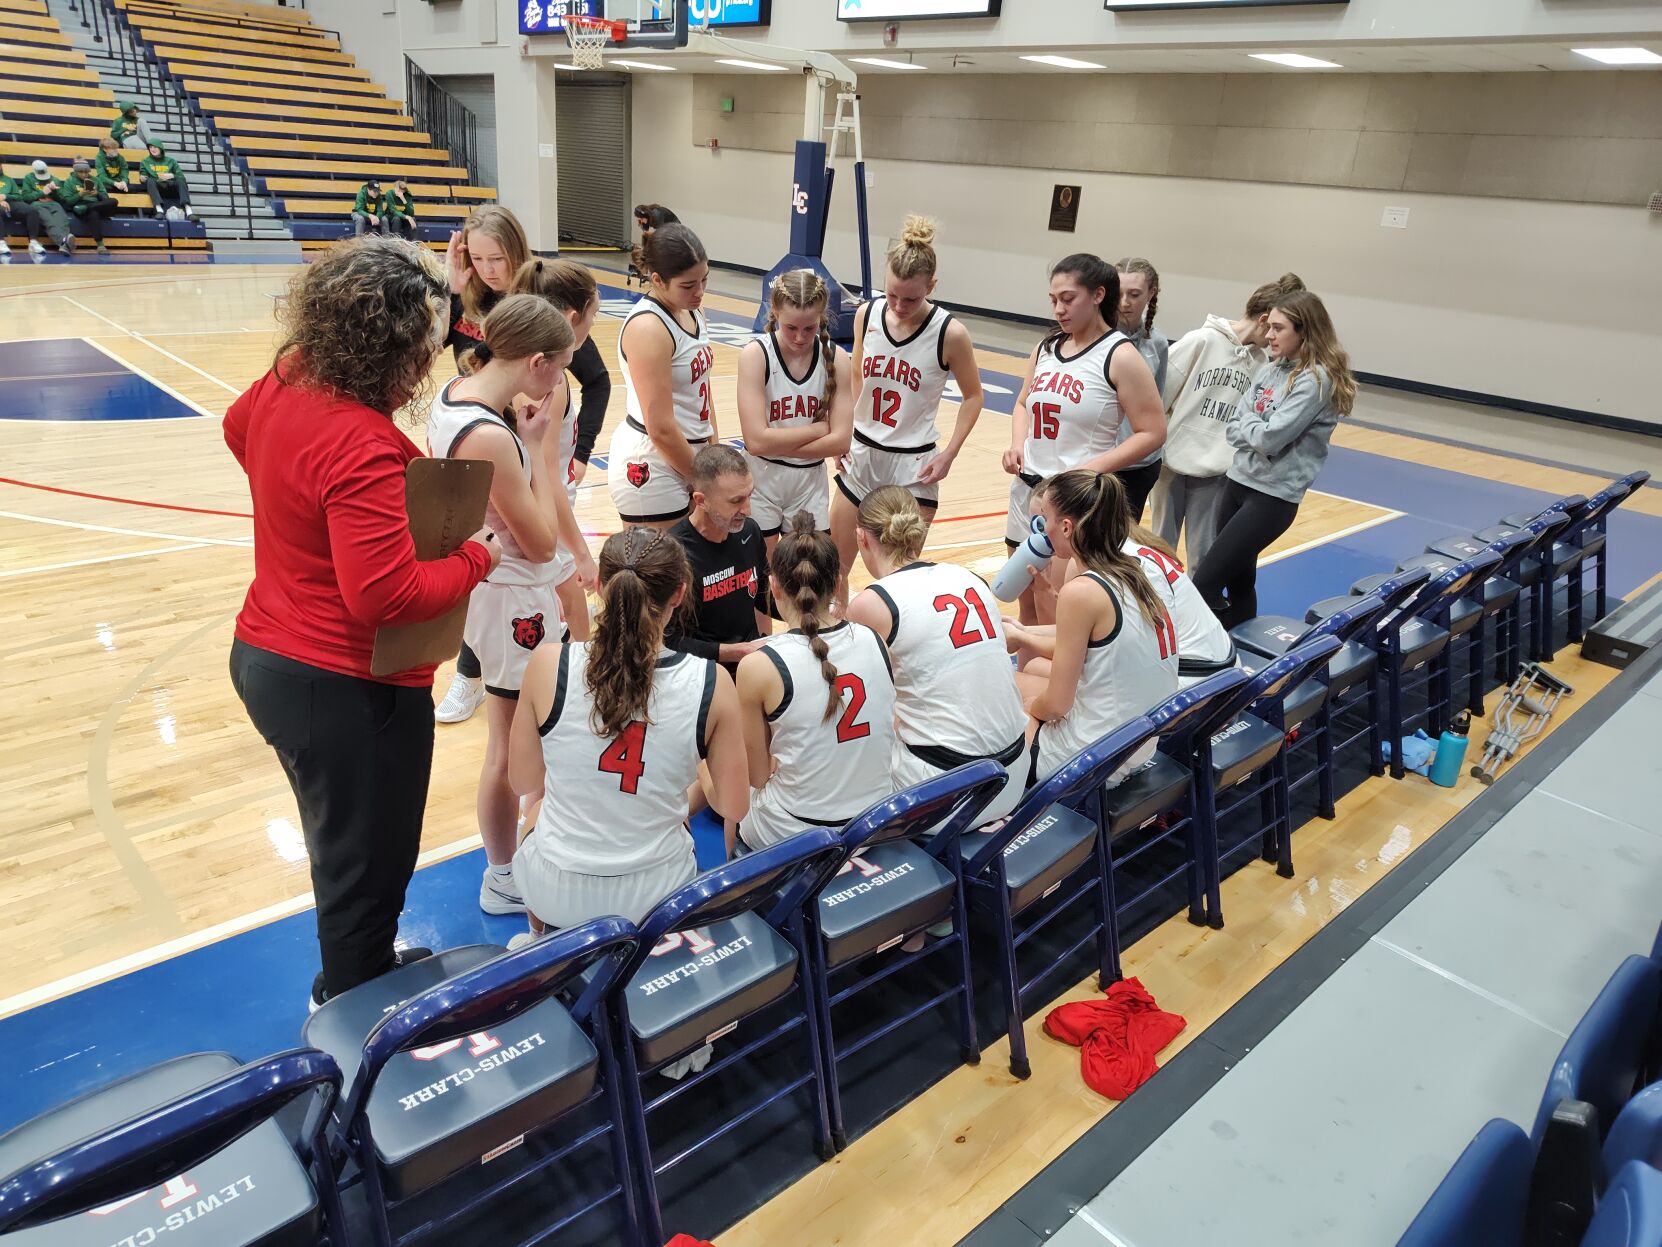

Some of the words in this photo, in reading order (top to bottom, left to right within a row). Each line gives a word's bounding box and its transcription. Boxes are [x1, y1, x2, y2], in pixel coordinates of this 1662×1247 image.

[690, 346, 714, 385] BEAR
[863, 355, 922, 392] BEARS
[1194, 367, 1232, 391] NORTH
[1231, 370, 1252, 395] SHO
[769, 394, 821, 423] BEAR
[872, 386, 902, 428] 12
[1031, 401, 1062, 440] 15
[702, 565, 735, 587] MOSCOW
[932, 586, 997, 649] 21
[832, 672, 870, 744] 2
[598, 720, 647, 795] 4
[822, 862, 915, 907] LEWIS-CLARK
[639, 935, 752, 996] LEWIS-CLARK
[398, 1032, 546, 1111] LEWIS-CLARK
[109, 1174, 256, 1247] LEWIS-CL
